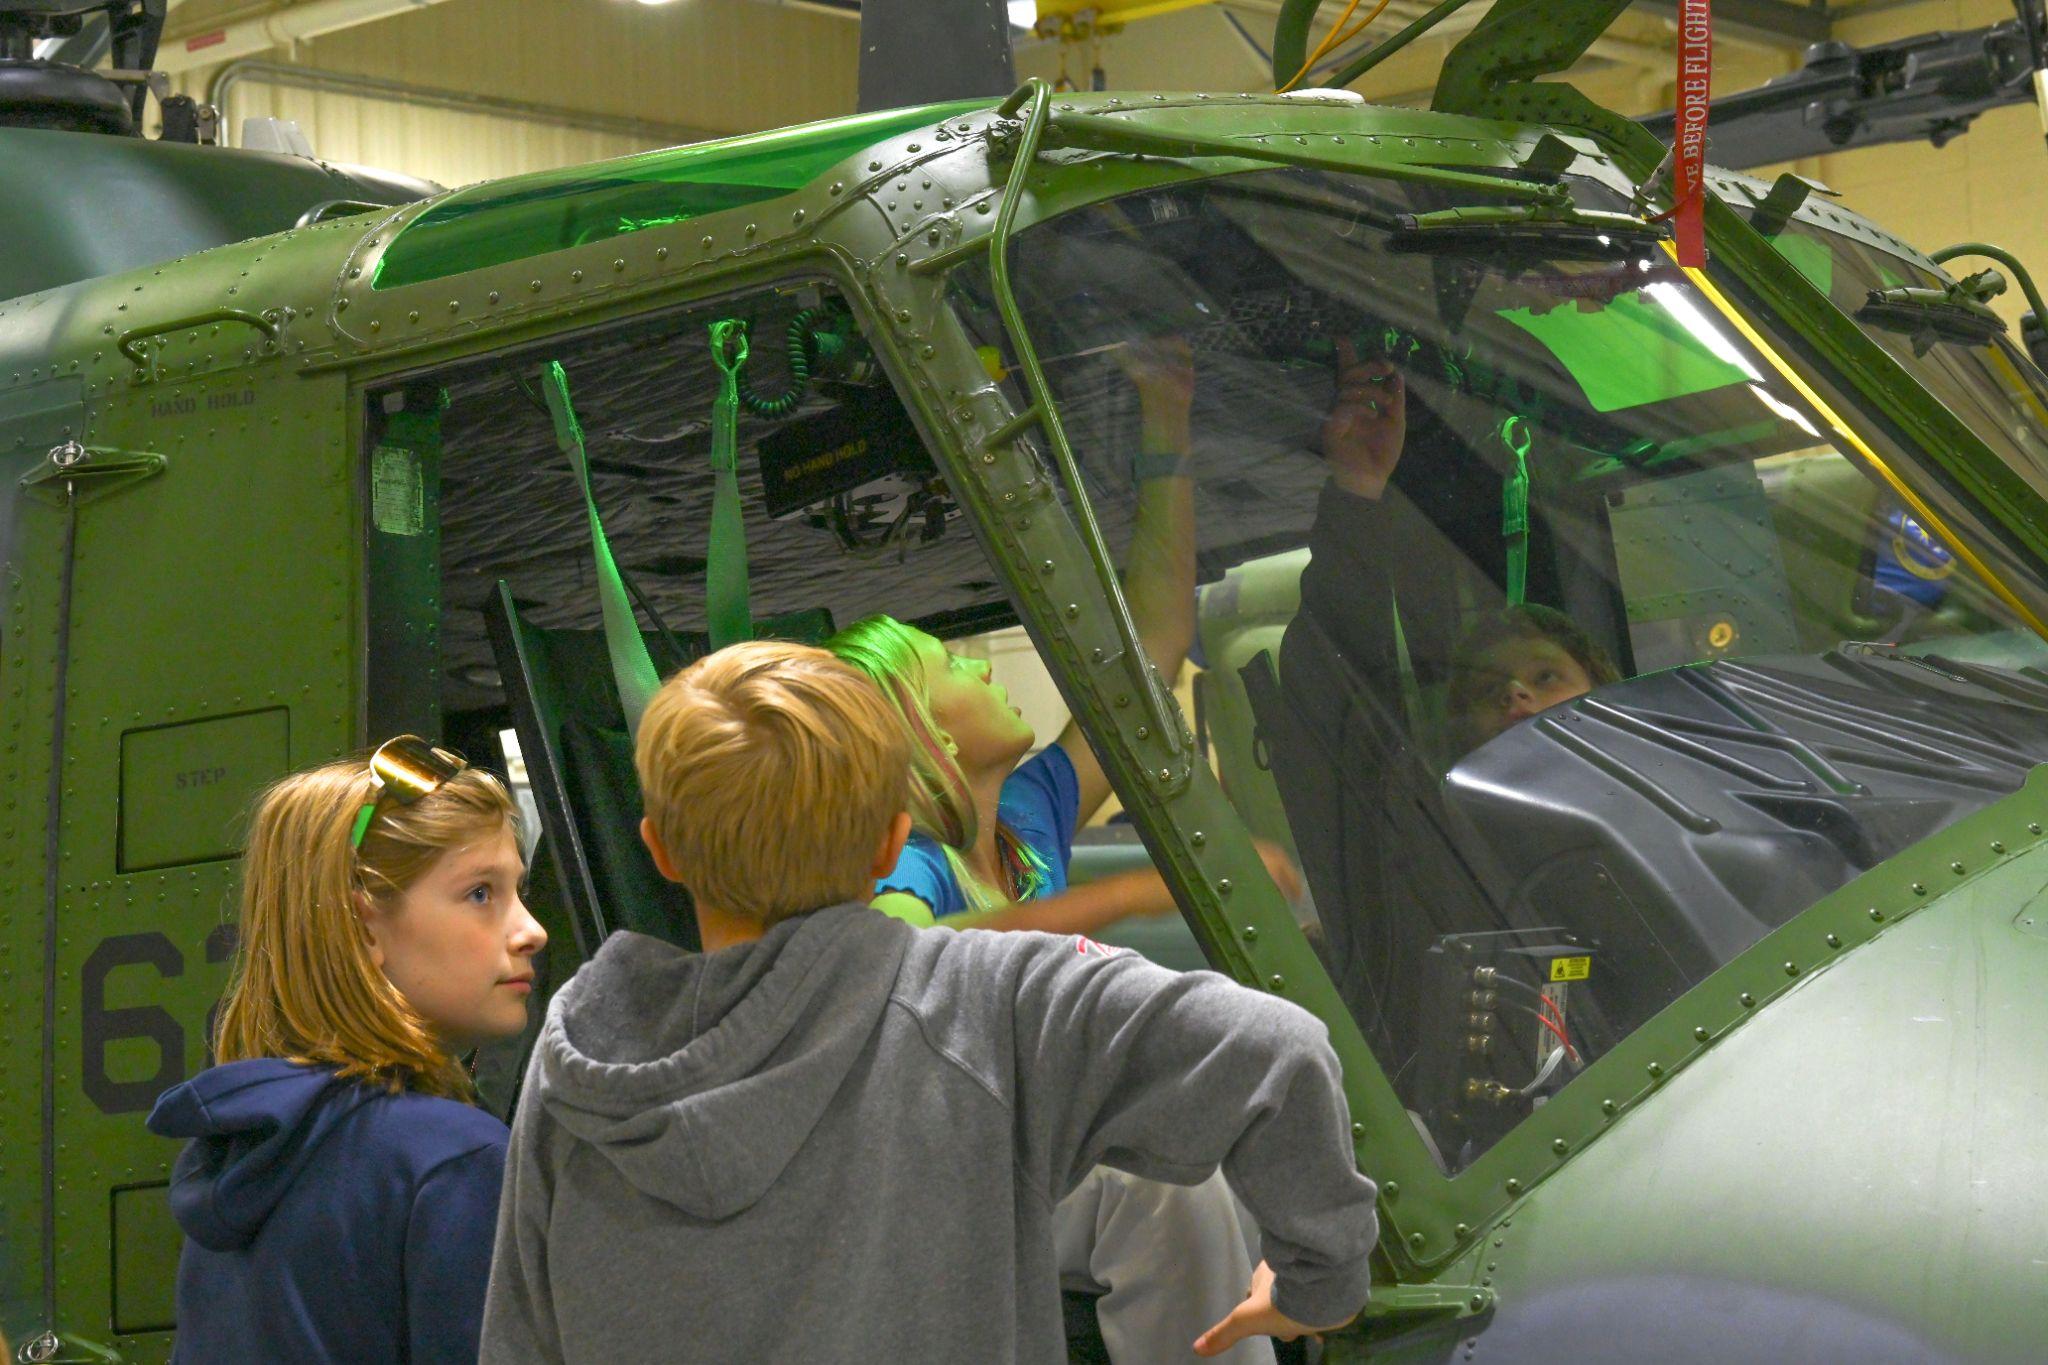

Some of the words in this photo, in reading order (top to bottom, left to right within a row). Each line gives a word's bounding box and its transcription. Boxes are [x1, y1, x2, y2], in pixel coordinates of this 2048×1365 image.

[1684, 0, 1708, 75] FLIGHT
[1683, 79, 1708, 160] BEFORE
[175, 767, 227, 790] STEP
